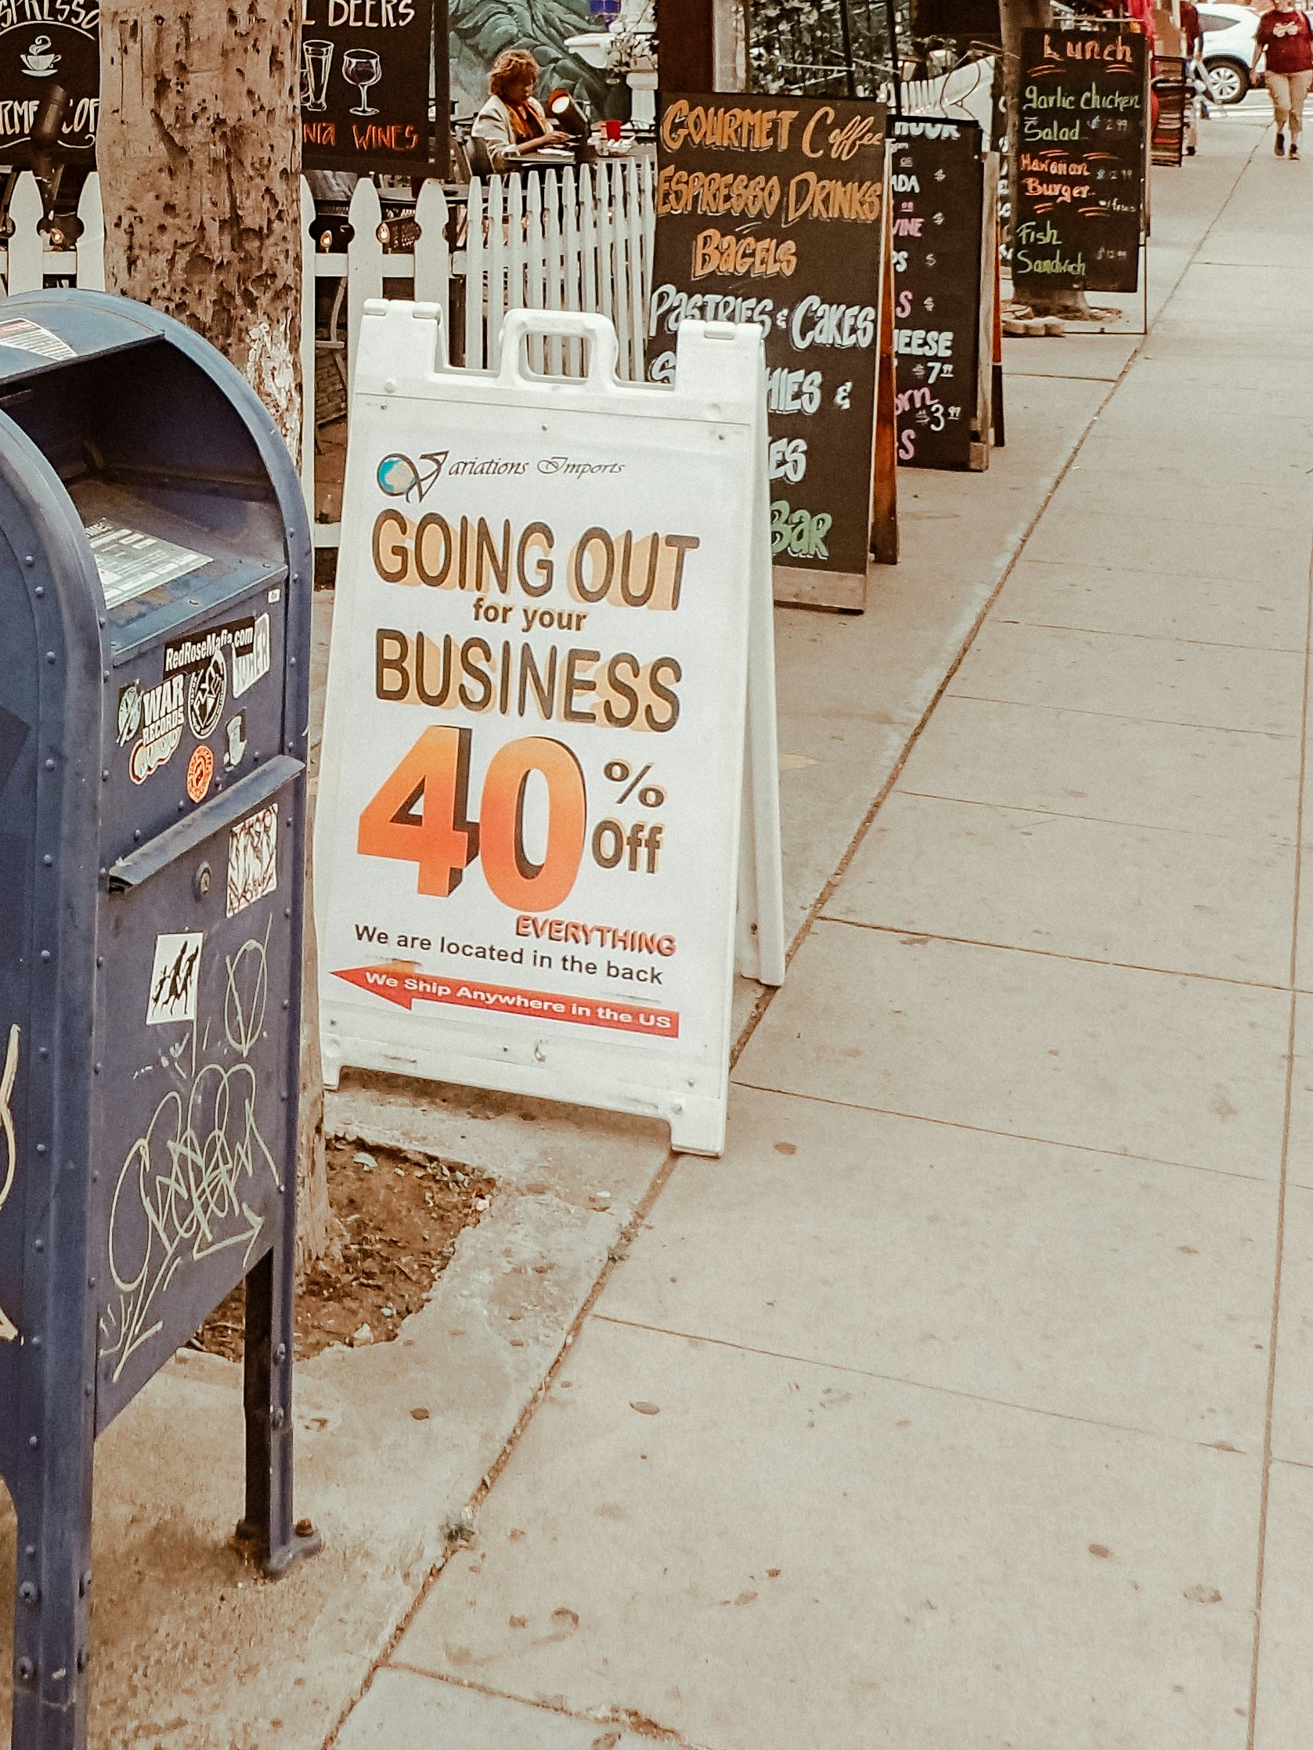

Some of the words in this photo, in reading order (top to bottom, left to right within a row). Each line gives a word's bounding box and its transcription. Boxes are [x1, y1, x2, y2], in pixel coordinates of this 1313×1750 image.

[1044, 33, 1134, 63] Lunch
[353, 123, 419, 151] WINES
[662, 99, 795, 154] GOURMET
[802, 106, 883, 163] Coffee
[1024, 118, 1080, 141] Salad
[656, 171, 782, 220] ESPRESSO
[782, 170, 883, 228] DRINKS
[1023, 176, 1091, 203] Burger
[1016, 220, 1063, 245] Fish
[1017, 249, 1086, 276] Sandwich
[537, 455, 626, 480] Imports
[768, 437, 809, 485] ES
[371, 507, 556, 600] GOING
[568, 523, 700, 612] OUT
[472, 596, 514, 627] for
[521, 602, 589, 633] your
[165, 626, 254, 673] RedRoseMafia.com
[143, 673, 185, 727] WAR
[374, 627, 683, 734] BUSINESS
[142, 704, 186, 749] RECORDS
[357, 723, 588, 915] 40
[591, 818, 665, 875] Off
[354, 922, 390, 947] We
[396, 931, 433, 951] are
[440, 936, 525, 966] located
[533, 949, 553, 969] in
[561, 954, 598, 976] the
[606, 959, 664, 986] back
[514, 914, 678, 957] EVERYTHING
[365, 969, 399, 988] We
[403, 976, 453, 998] Ship
[455, 984, 567, 1014] Anywhere
[571, 1002, 592, 1018] in
[596, 1006, 633, 1024] the
[638, 1012, 673, 1030] US
